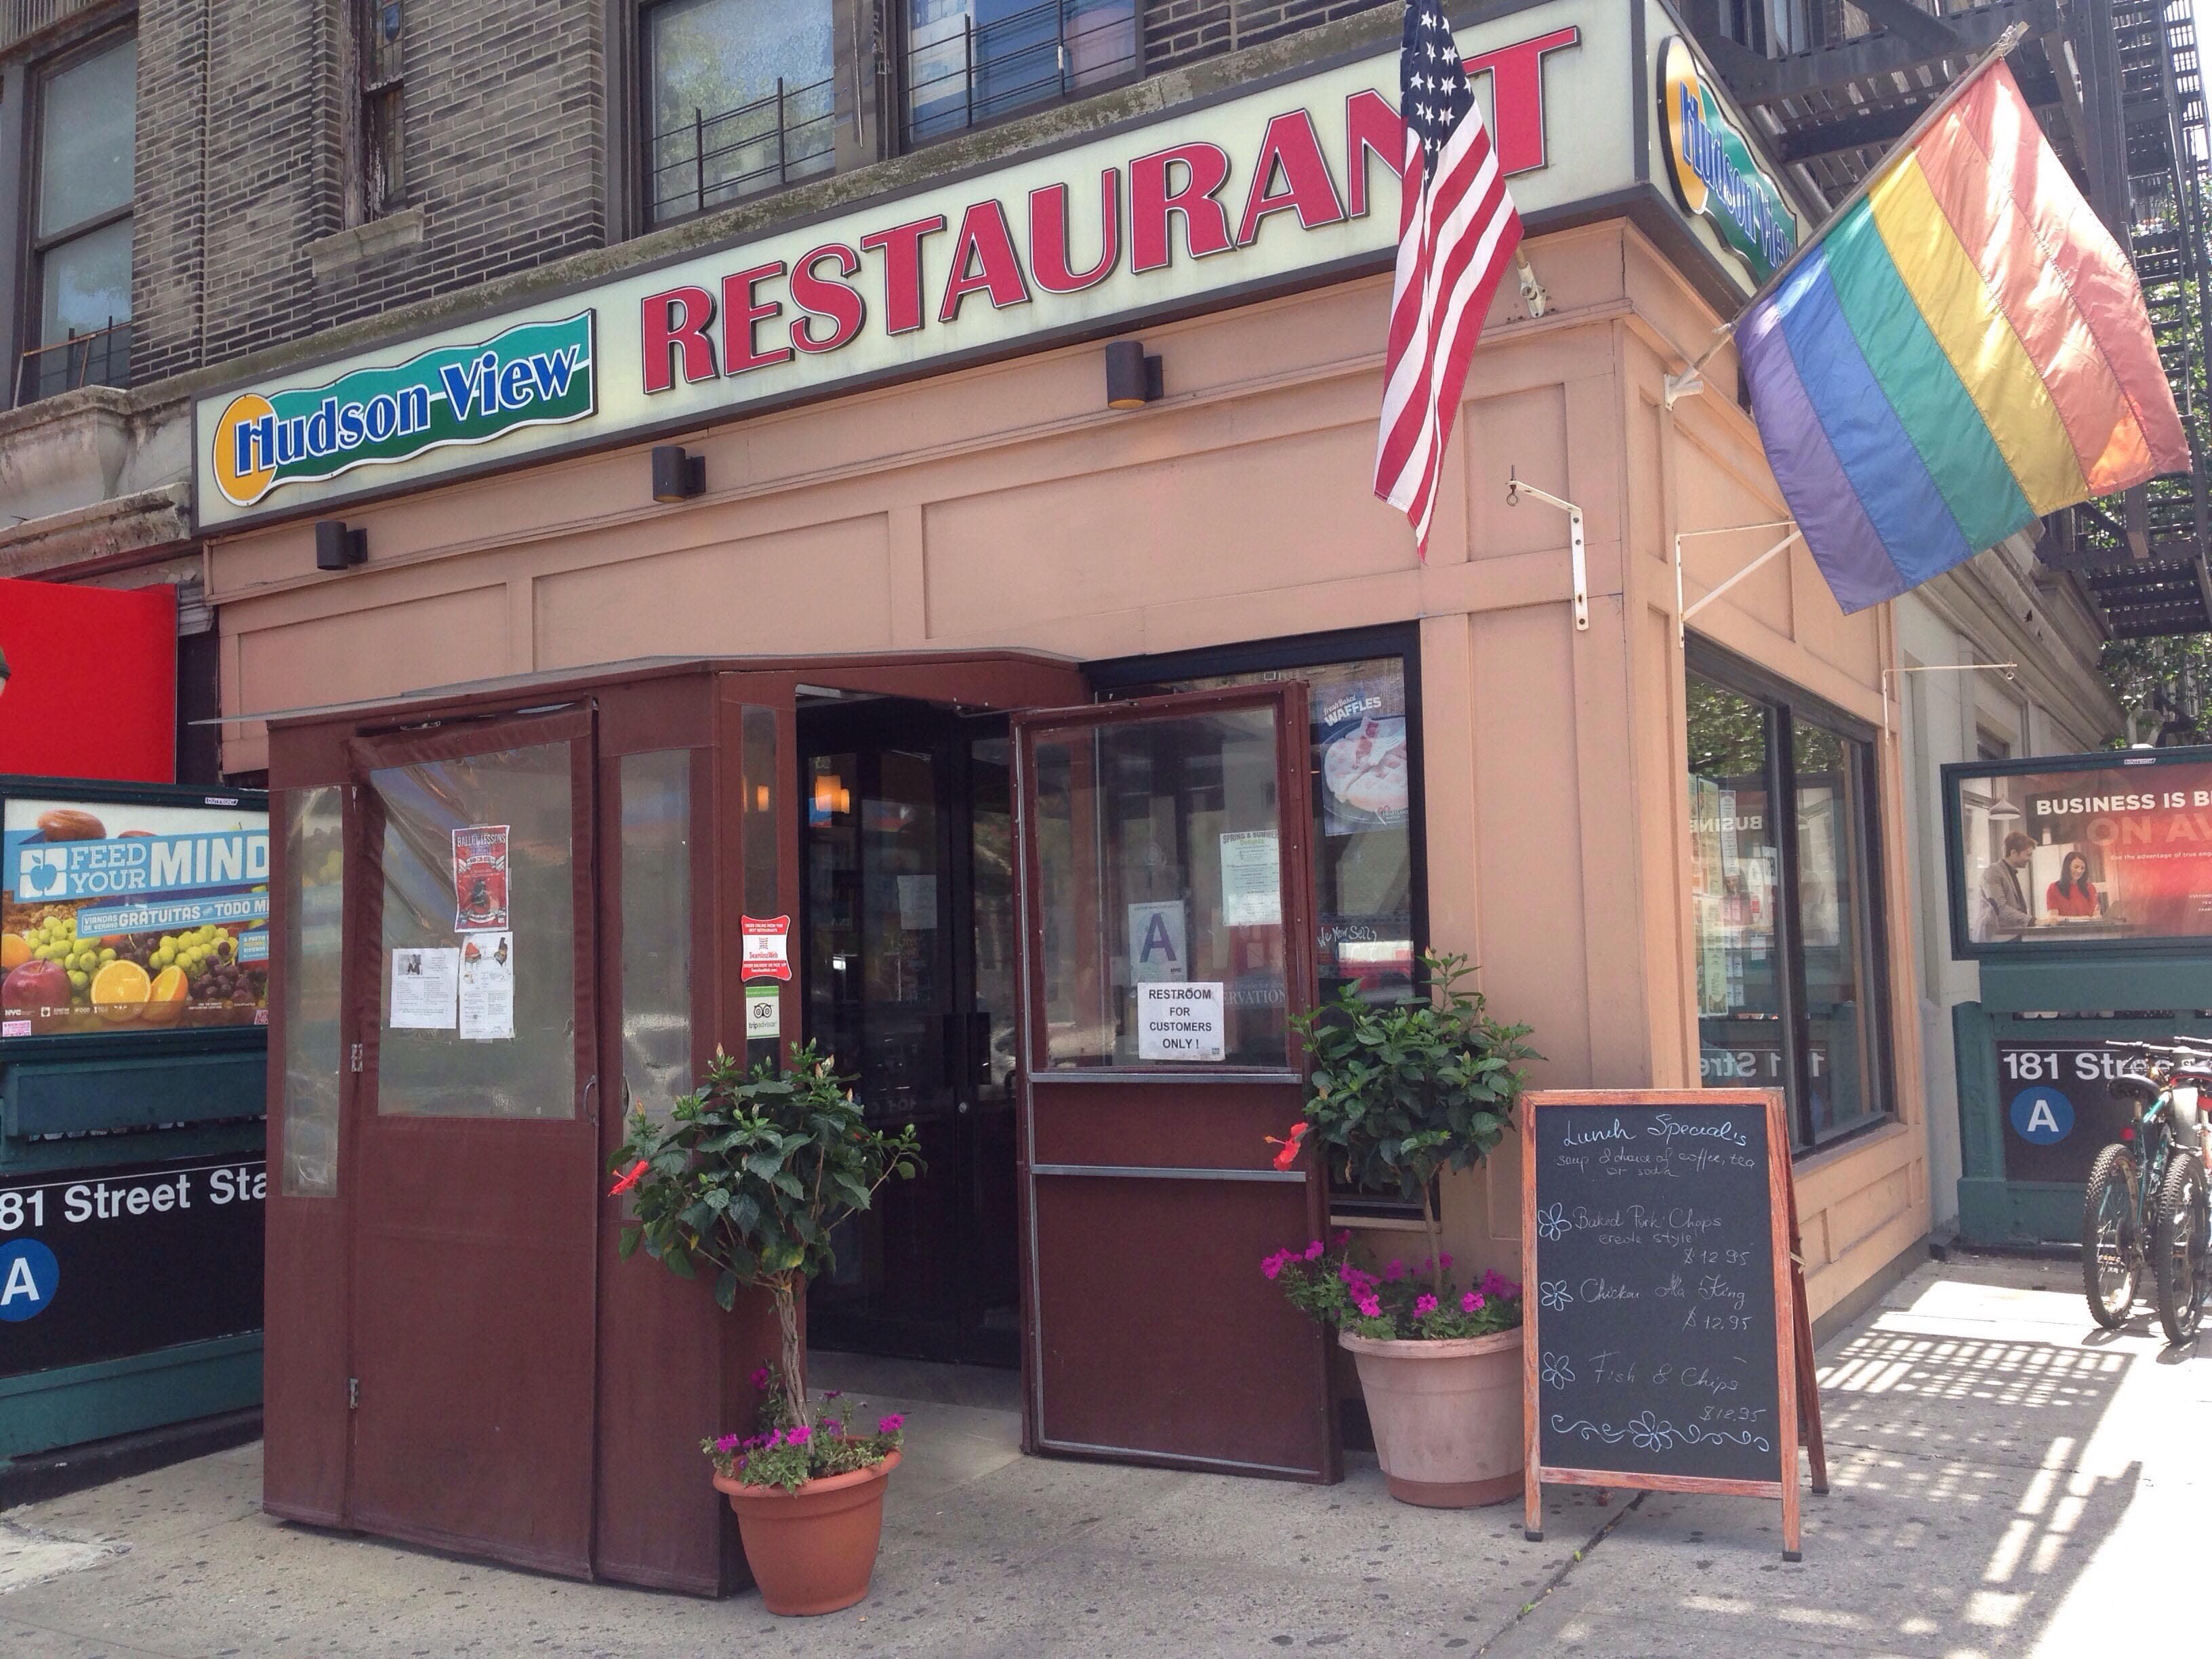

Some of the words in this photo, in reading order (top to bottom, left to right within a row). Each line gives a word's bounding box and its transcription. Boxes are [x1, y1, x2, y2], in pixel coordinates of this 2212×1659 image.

[1679, 81, 1757, 245] Hudson
[639, 25, 1581, 395] RESTAURANT
[234, 384, 431, 478] Hudson
[439, 344, 581, 422] View
[1324, 697, 1382, 726] WAFFLES
[2036, 793, 2156, 815] BUSINESS
[2163, 792, 2186, 808] IS
[2194, 790, 2212, 806] B
[1223, 834, 1245, 844] SPRING
[2087, 815, 2152, 846] ON
[70, 842, 146, 869] FEED
[150, 835, 270, 888] MIND
[2137, 853, 2172, 861] advantage
[70, 868, 146, 894] YOUR
[84, 915, 117, 924] VIANDAS
[119, 905, 201, 927] GRATUITAS
[214, 900, 251, 916] TODO
[1139, 913, 1177, 962] A
[1317, 926, 1332, 947] We
[1149, 988, 1212, 1000] RESTROOM
[1170, 1007, 1190, 1016] FOR
[1149, 1021, 1212, 1031] CUSTOMERS
[1162, 1038, 1192, 1048] ONLY
[2003, 1052, 2059, 1080] 181
[2027, 1099, 2060, 1132] A
[1563, 1118, 1637, 1146] Lunch
[1556, 1155, 1589, 1173] soup
[1614, 1146, 1652, 1163] choice
[1656, 1147, 1674, 1170] of
[1729, 1153, 1755, 1169] tea
[1606, 1167, 1628, 1176] or
[1637, 1166, 1679, 1177] soda
[64, 1174, 190, 1223] Street
[1572, 1206, 1625, 1229] Baked
[1626, 1205, 1662, 1229] Pork
[1669, 1208, 1723, 1234] Chops
[1599, 1231, 1643, 1244] creole
[1652, 1233, 1692, 1248] style
[1, 1257, 40, 1305] A
[1580, 1277, 1640, 1303] Chicken
[1698, 1274, 1746, 1310] King
[1589, 1350, 1635, 1384] Fish
[1681, 1367, 1739, 1396] Chips
